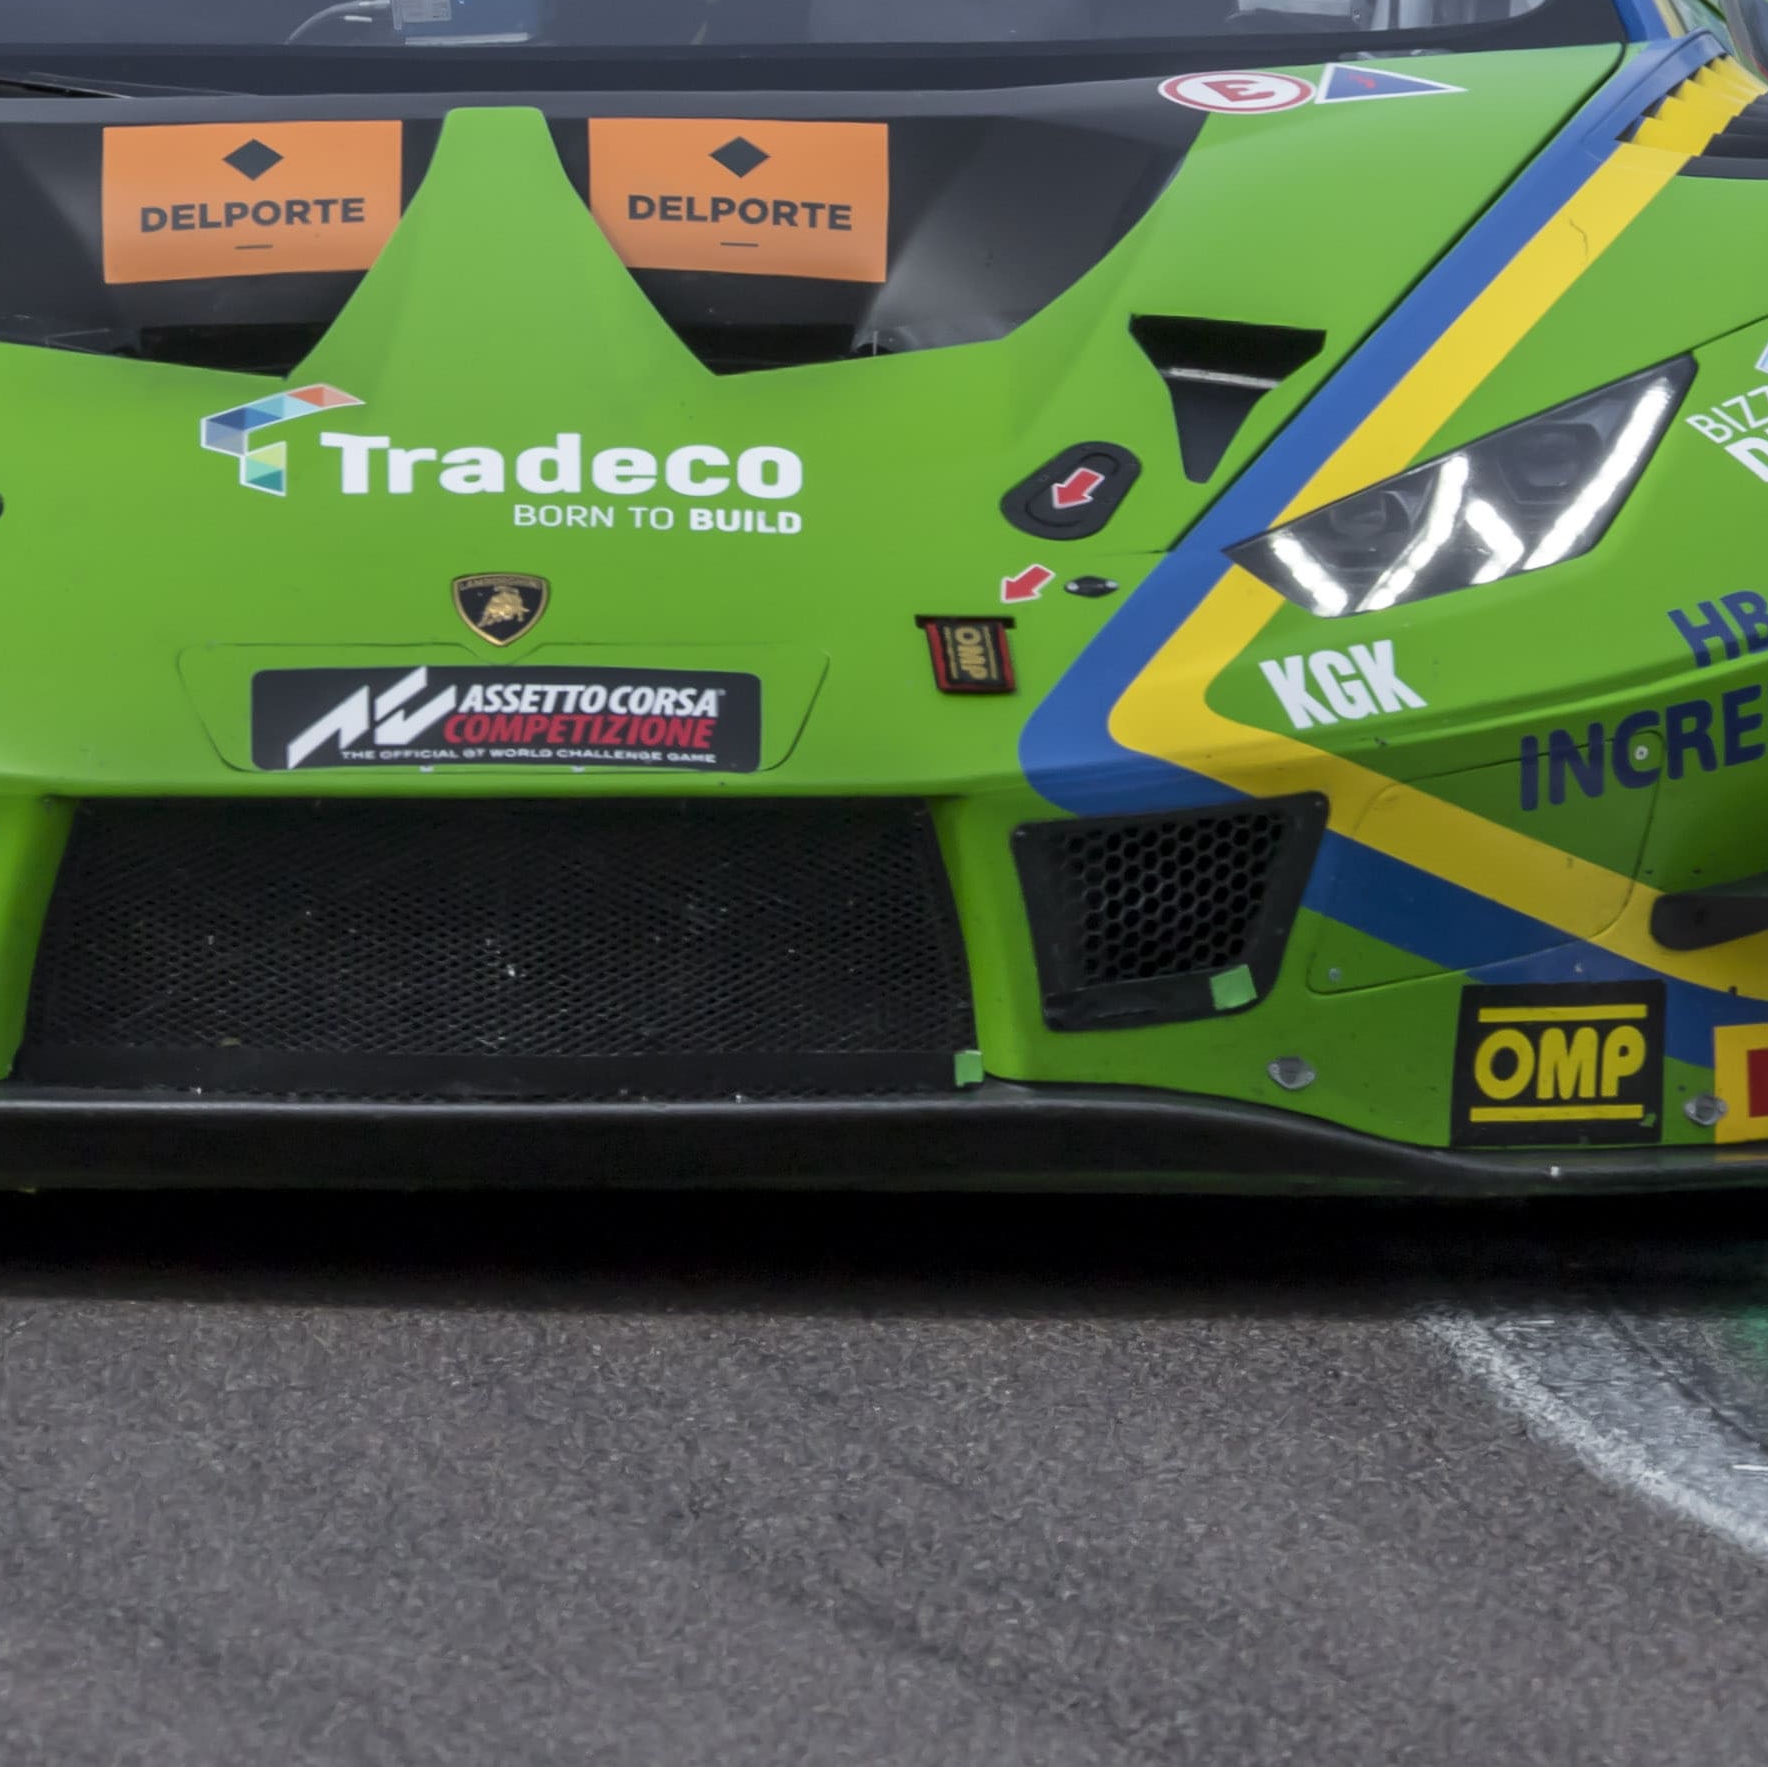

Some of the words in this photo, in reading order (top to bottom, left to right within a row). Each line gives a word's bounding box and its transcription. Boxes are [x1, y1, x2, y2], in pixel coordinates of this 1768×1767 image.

[140, 196, 366, 233] DELPORTE
[628, 193, 853, 232] DELPORTE
[319, 431, 804, 500] Tradeco
[513, 503, 615, 529] BORN
[628, 505, 675, 531] TO
[689, 507, 803, 535] BUILD
[458, 683, 608, 715] ASSETTO
[1259, 638, 1429, 731] KGK
[443, 713, 717, 749] COMPETIZIONE
[342, 749, 376, 760] THE
[380, 748, 459, 760] OFFICIAL
[462, 748, 486, 759] GT
[489, 747, 552, 759] WORLD
[556, 747, 663, 762] CHALLENGE
[667, 751, 717, 764] GAME
[1474, 1024, 1647, 1101] OMP
